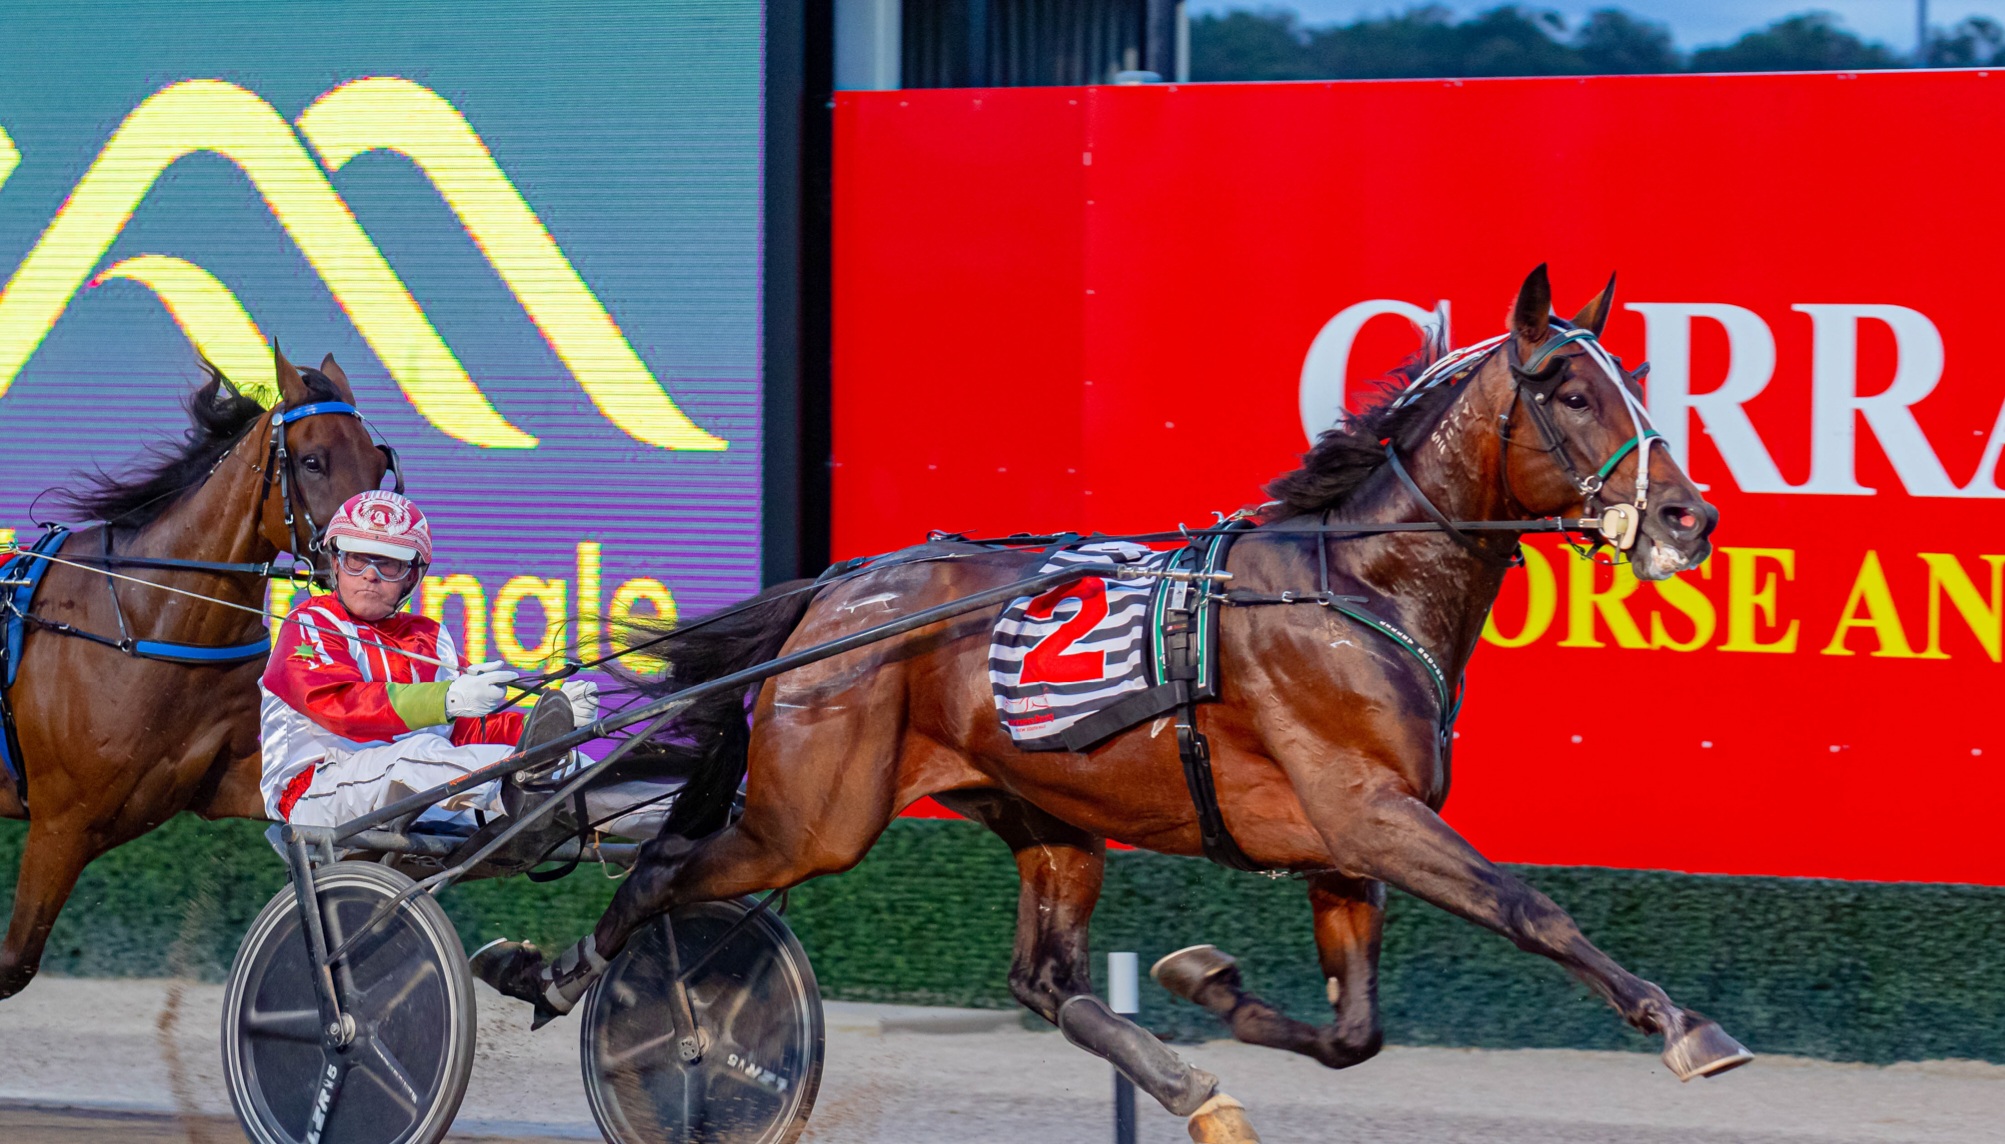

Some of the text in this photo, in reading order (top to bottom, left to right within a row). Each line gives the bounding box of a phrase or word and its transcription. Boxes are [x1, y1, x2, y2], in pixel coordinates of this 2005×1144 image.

[1298, 298, 2005, 498] CRR
[269, 541, 679, 709] ngle
[1018, 575, 1110, 687] 2
[1481, 540, 1800, 654] ORSE
